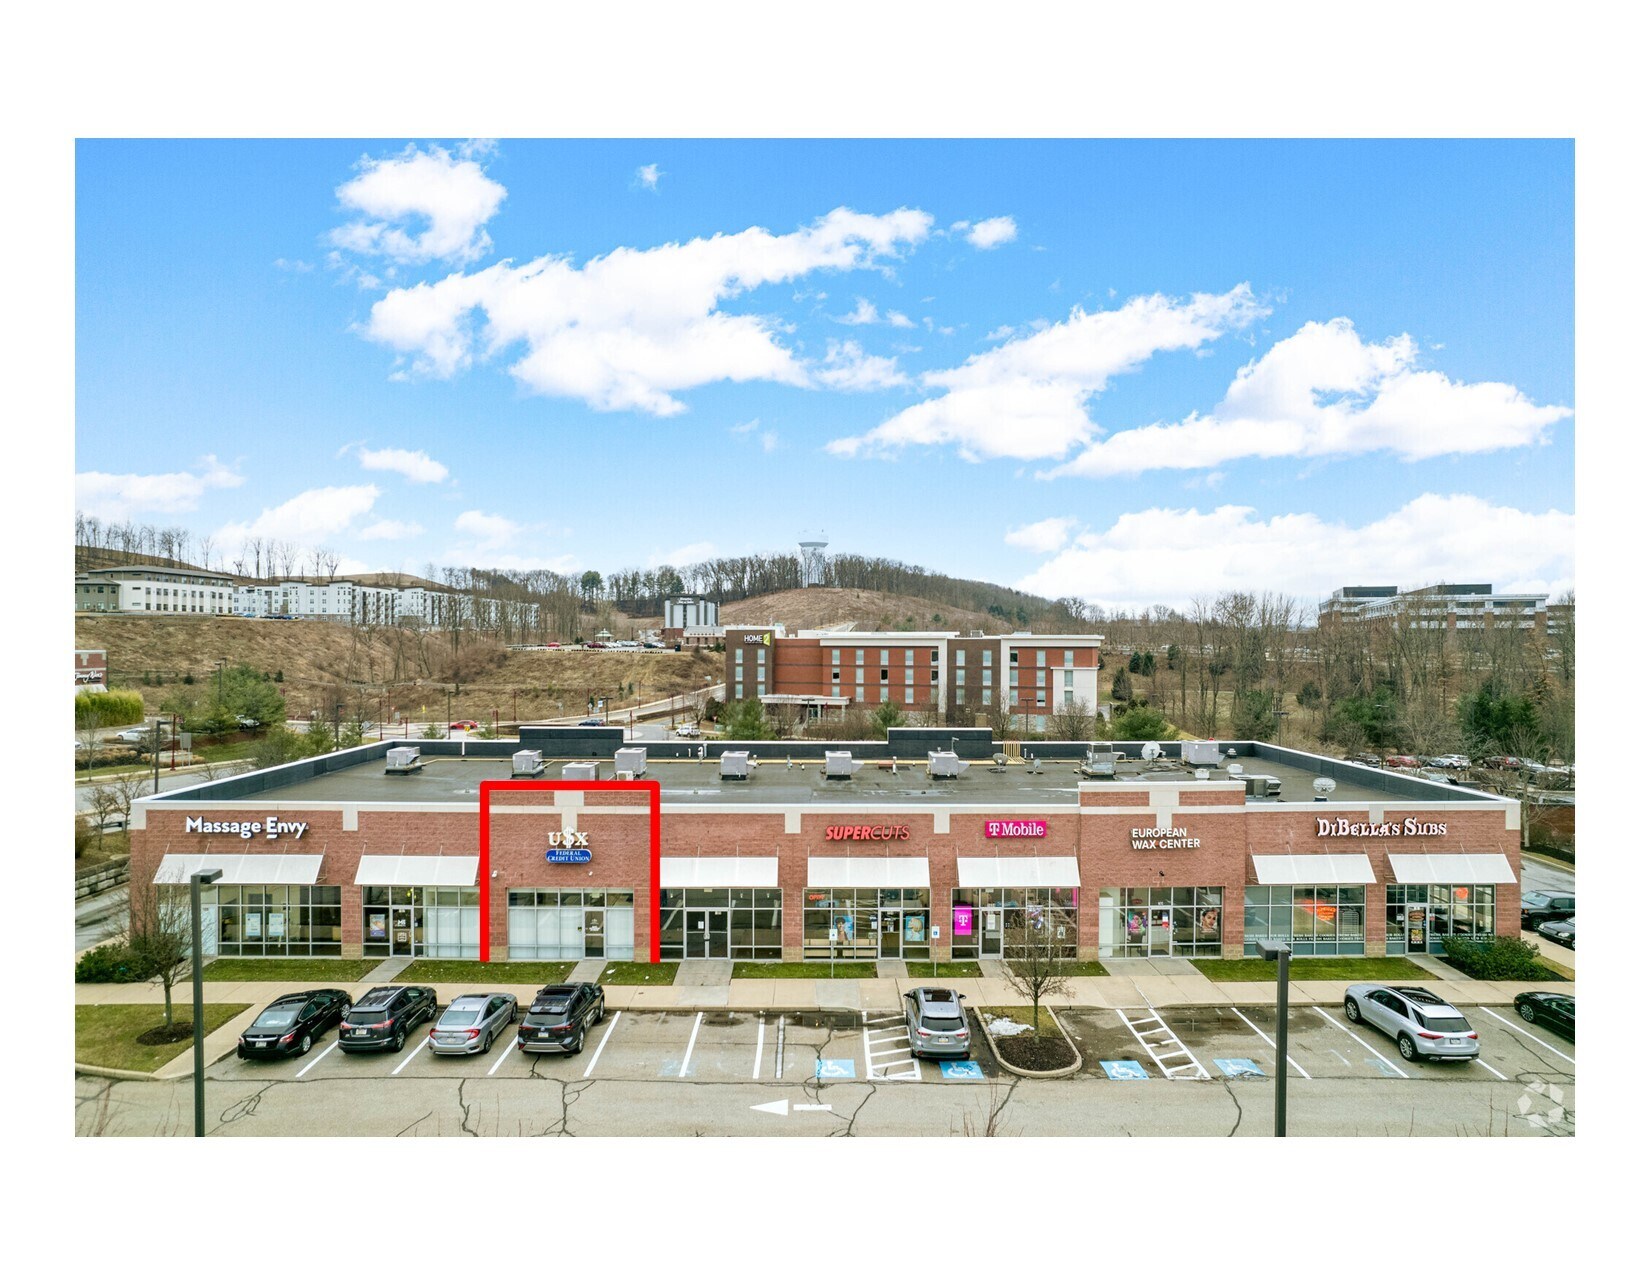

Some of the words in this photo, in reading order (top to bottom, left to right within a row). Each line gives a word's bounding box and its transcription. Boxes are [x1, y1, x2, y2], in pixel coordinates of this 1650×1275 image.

[744, 634, 763, 642] HOME
[185, 816, 262, 838] Massage
[266, 816, 308, 839] Envy
[825, 825, 910, 840] SUPERCUTS
[989, 822, 1000, 836] T
[1001, 822, 1044, 836] Mobile
[1131, 828, 1187, 838] EUROPEAN
[1131, 839, 1157, 850] WAX
[1159, 838, 1201, 849] CENTER
[958, 914, 969, 927] T
